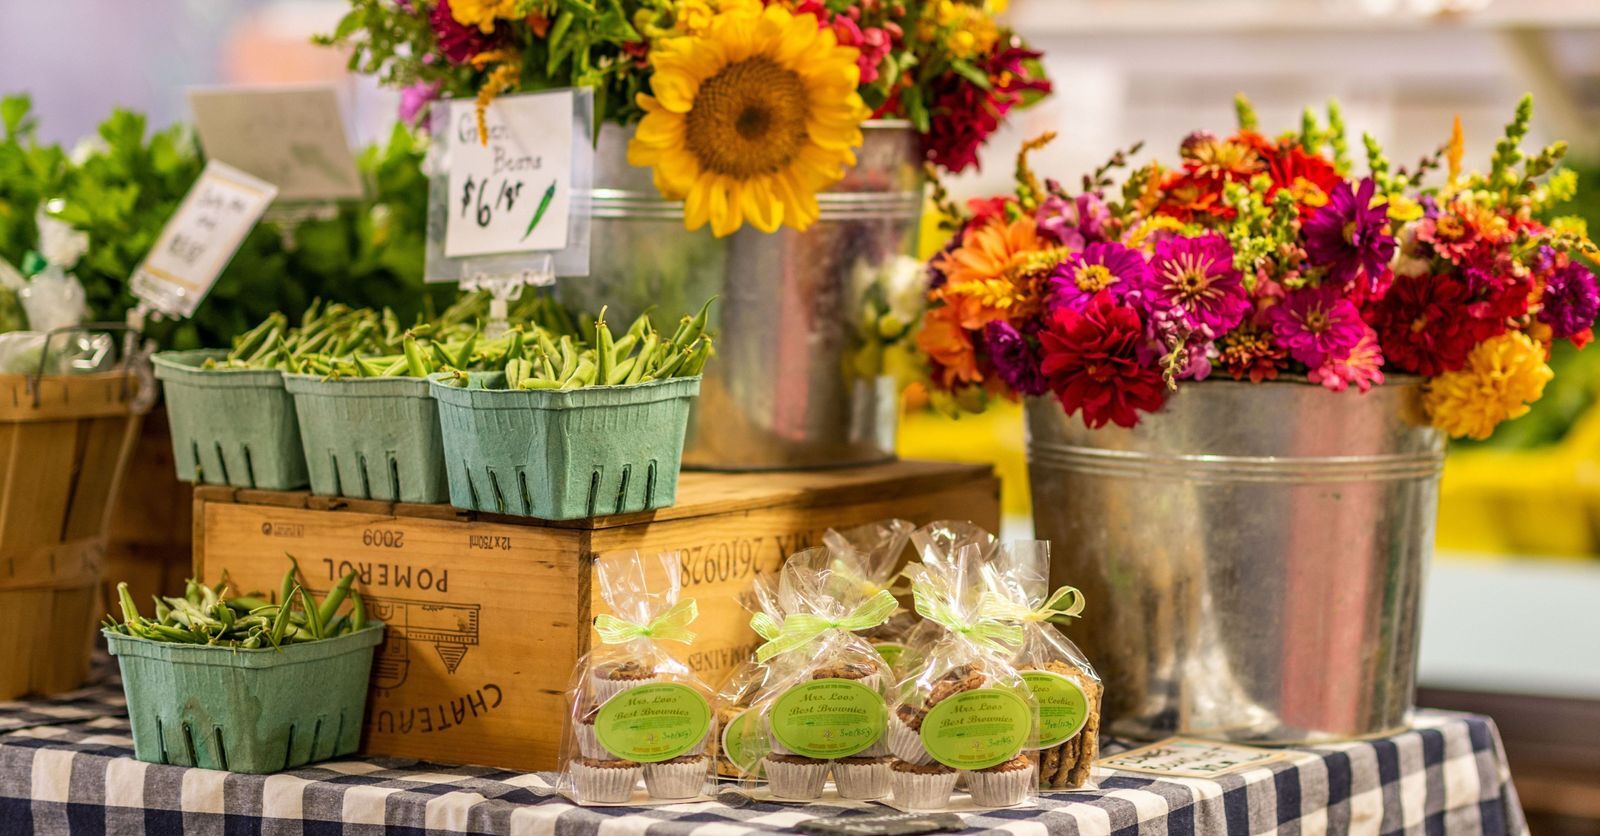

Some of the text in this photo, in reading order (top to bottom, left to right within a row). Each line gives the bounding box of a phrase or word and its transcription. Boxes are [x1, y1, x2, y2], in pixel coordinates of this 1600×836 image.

[458, 112, 509, 144] Gren
[493, 145, 542, 175] Beans
[362, 528, 404, 548] 2009
[323, 558, 448, 592] POMEROL
[623, 697, 650, 708] Mrs.
[799, 692, 826, 703] Mrs.
[1047, 696, 1074, 706] Cookies
[378, 683, 503, 734] CHATEAU
[613, 706, 689, 721] Best Brownies
[788, 704, 867, 717] Best Brownies
[950, 704, 976, 715] Mrs.
[939, 714, 1014, 729] Best Brownies
